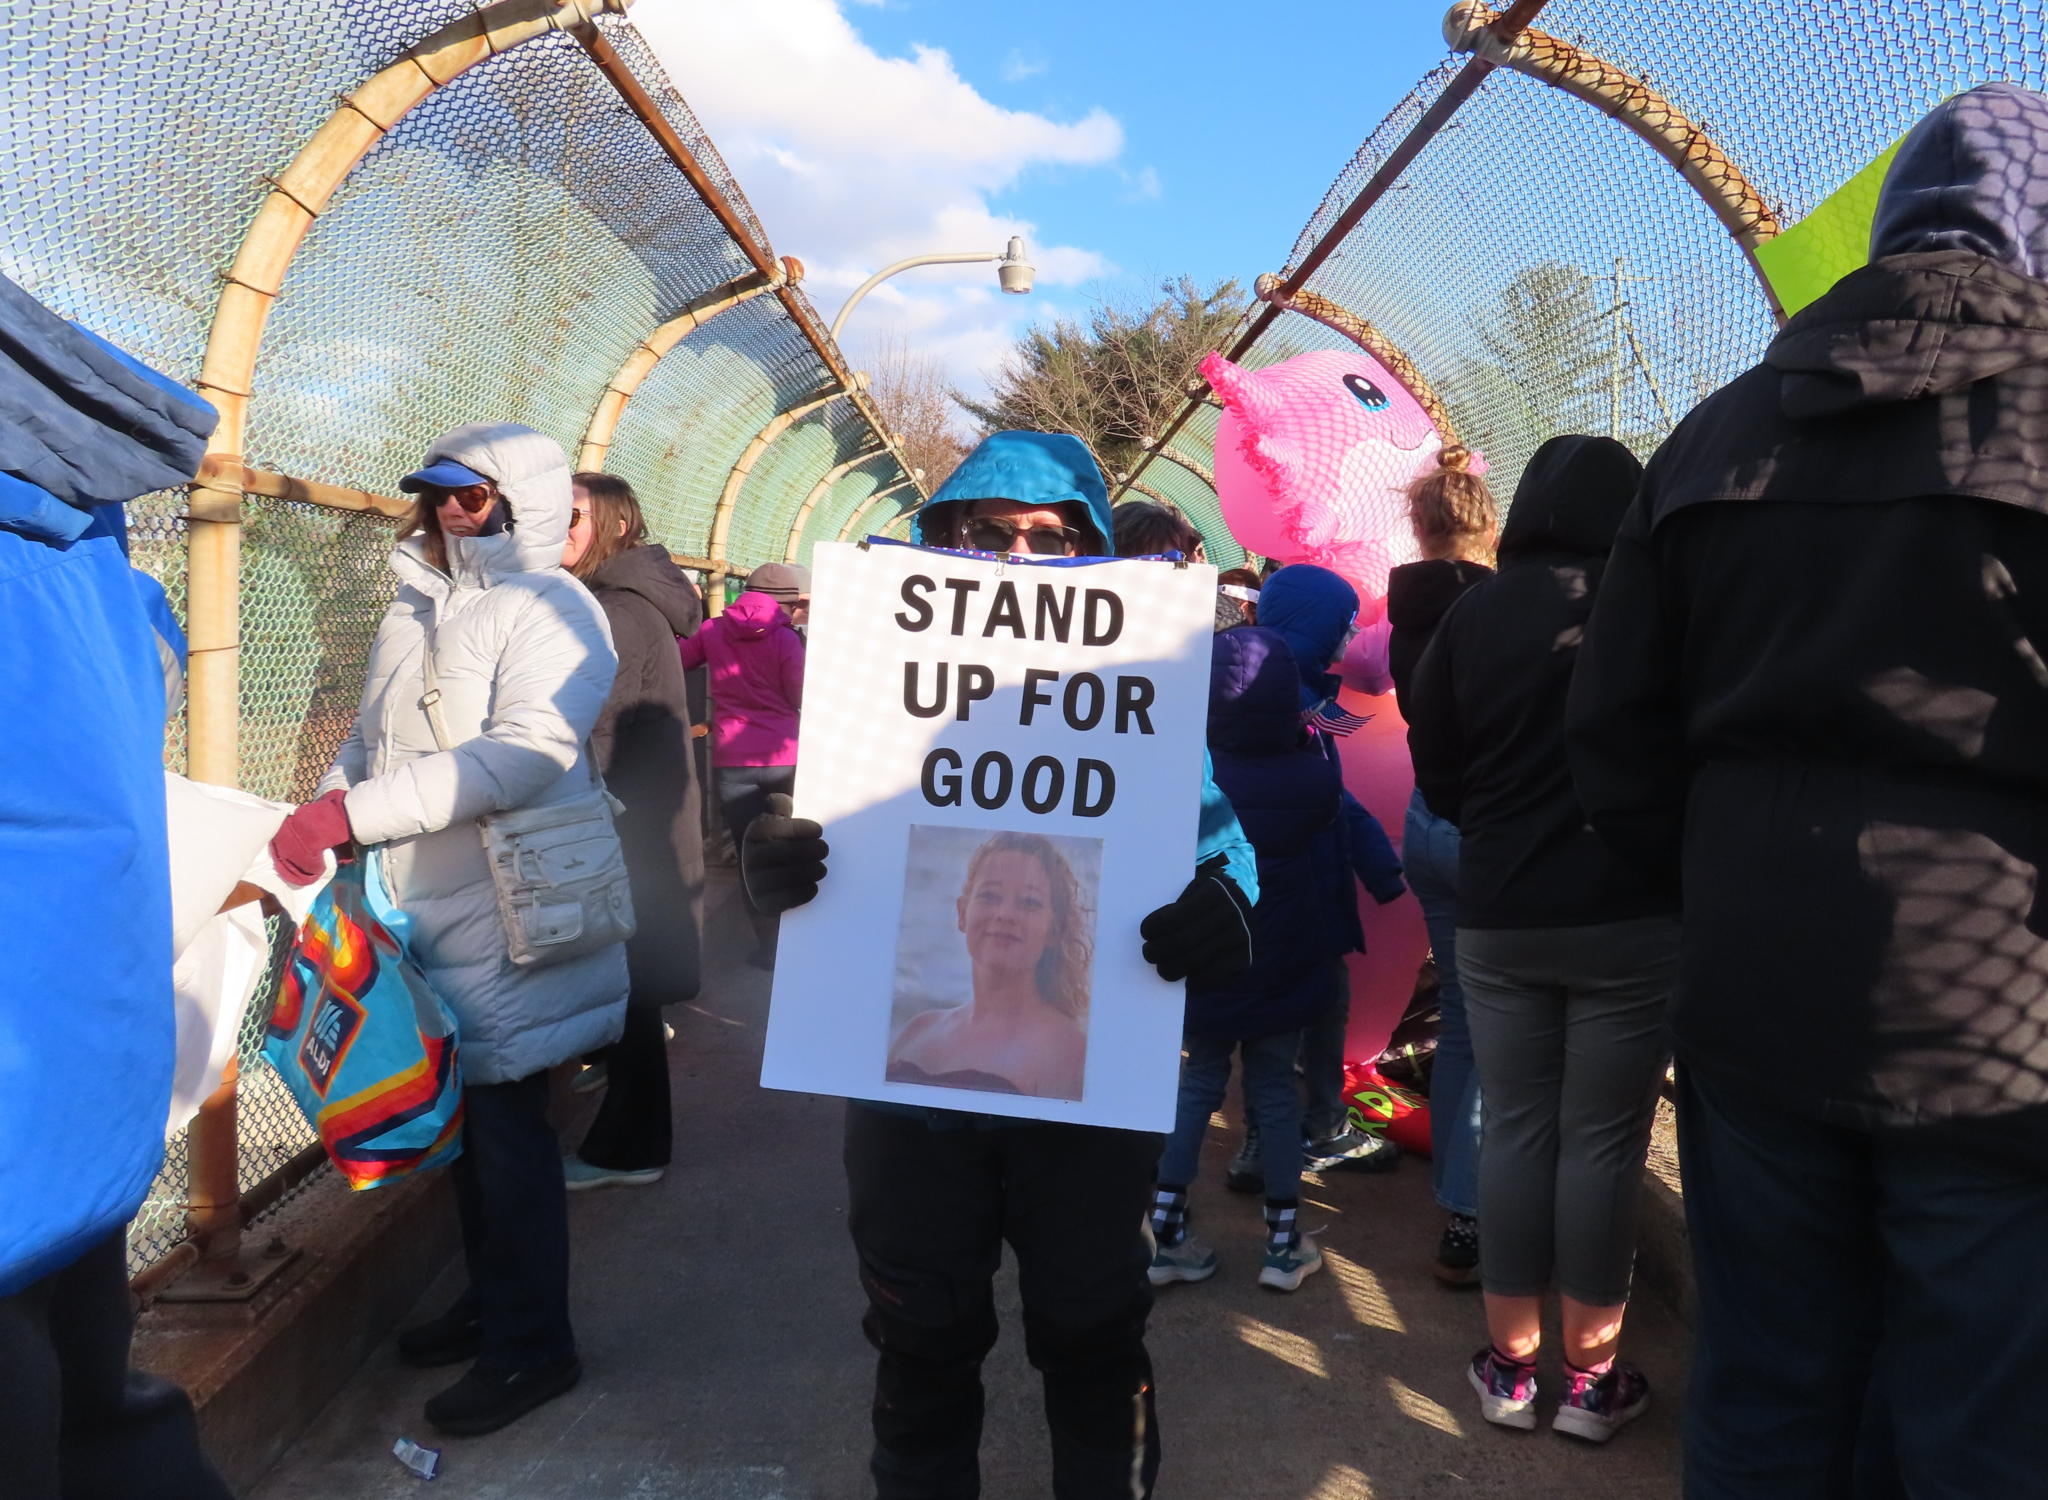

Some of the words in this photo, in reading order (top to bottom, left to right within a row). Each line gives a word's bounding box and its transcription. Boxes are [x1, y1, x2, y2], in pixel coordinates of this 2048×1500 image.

[894, 574, 1125, 646] STAND
[903, 662, 995, 722] UP
[1019, 668, 1156, 735] FOR
[920, 747, 1117, 818] GOOD
[306, 1036, 331, 1076] ALDI
